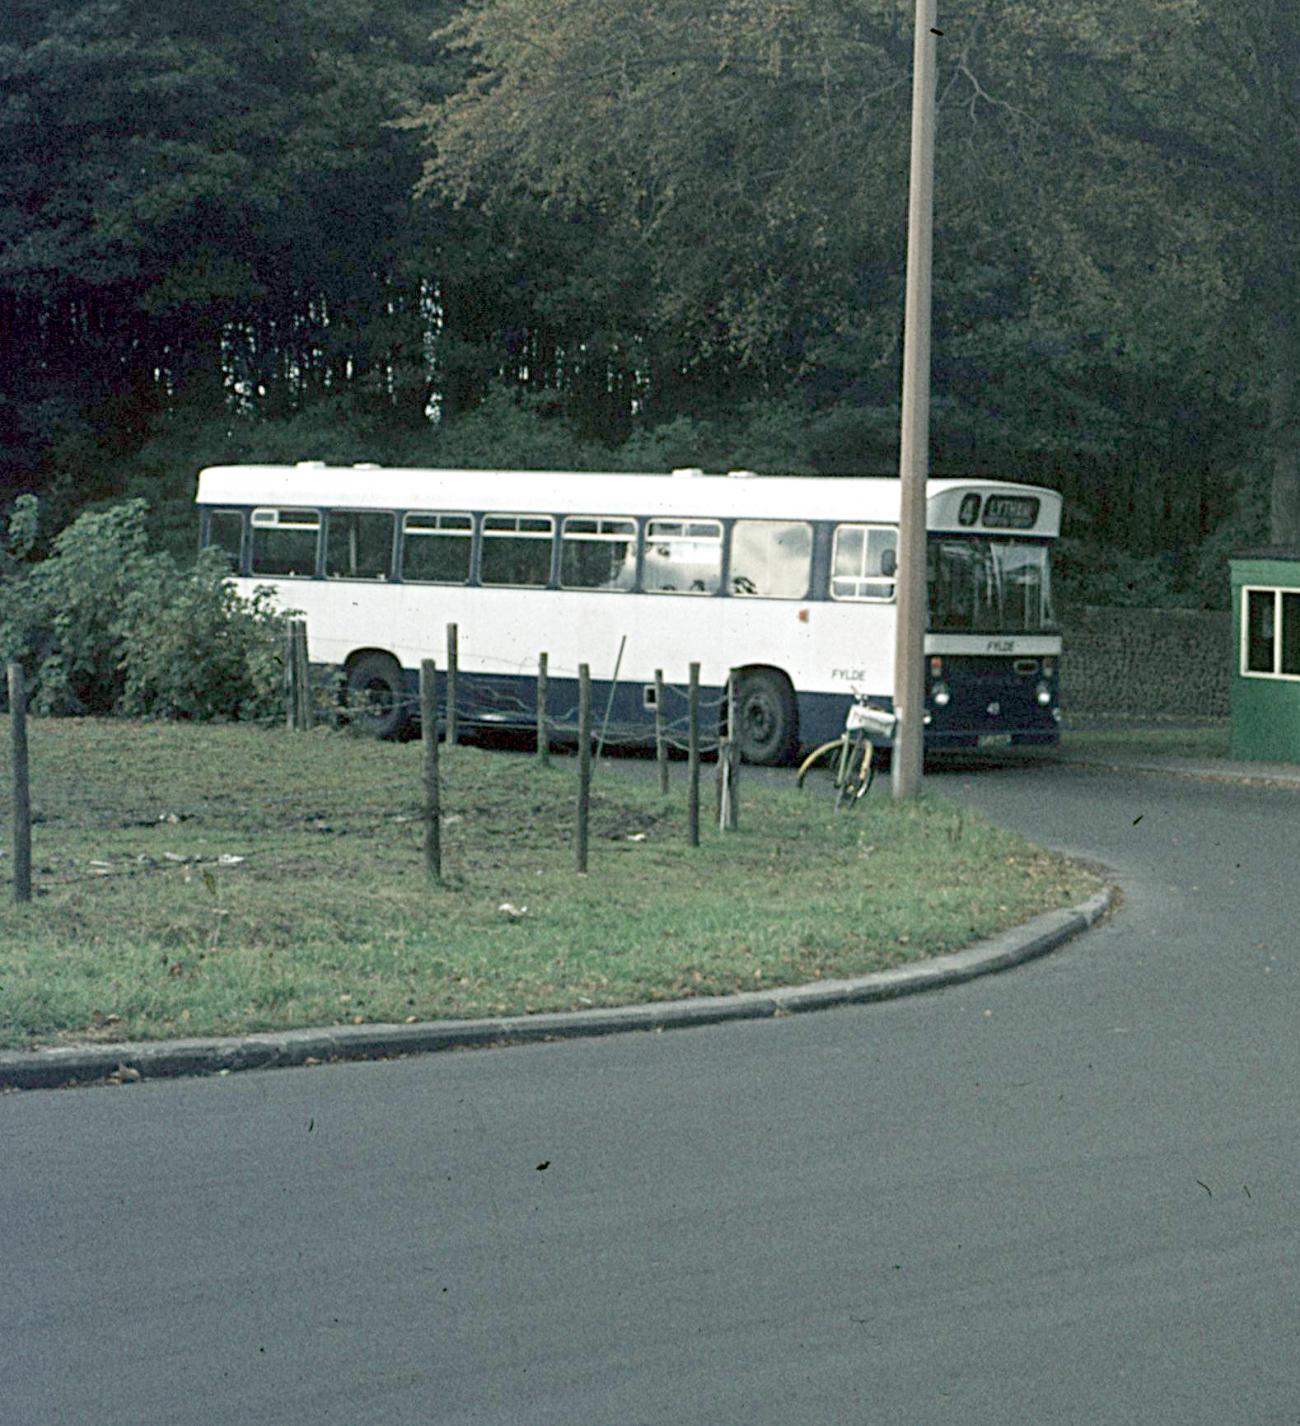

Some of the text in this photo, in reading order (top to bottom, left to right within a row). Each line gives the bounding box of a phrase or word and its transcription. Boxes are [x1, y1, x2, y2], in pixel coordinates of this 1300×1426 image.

[961, 499, 975, 525] 4
[986, 641, 1015, 652] FYLDE
[831, 669, 866, 681] FYLDE
